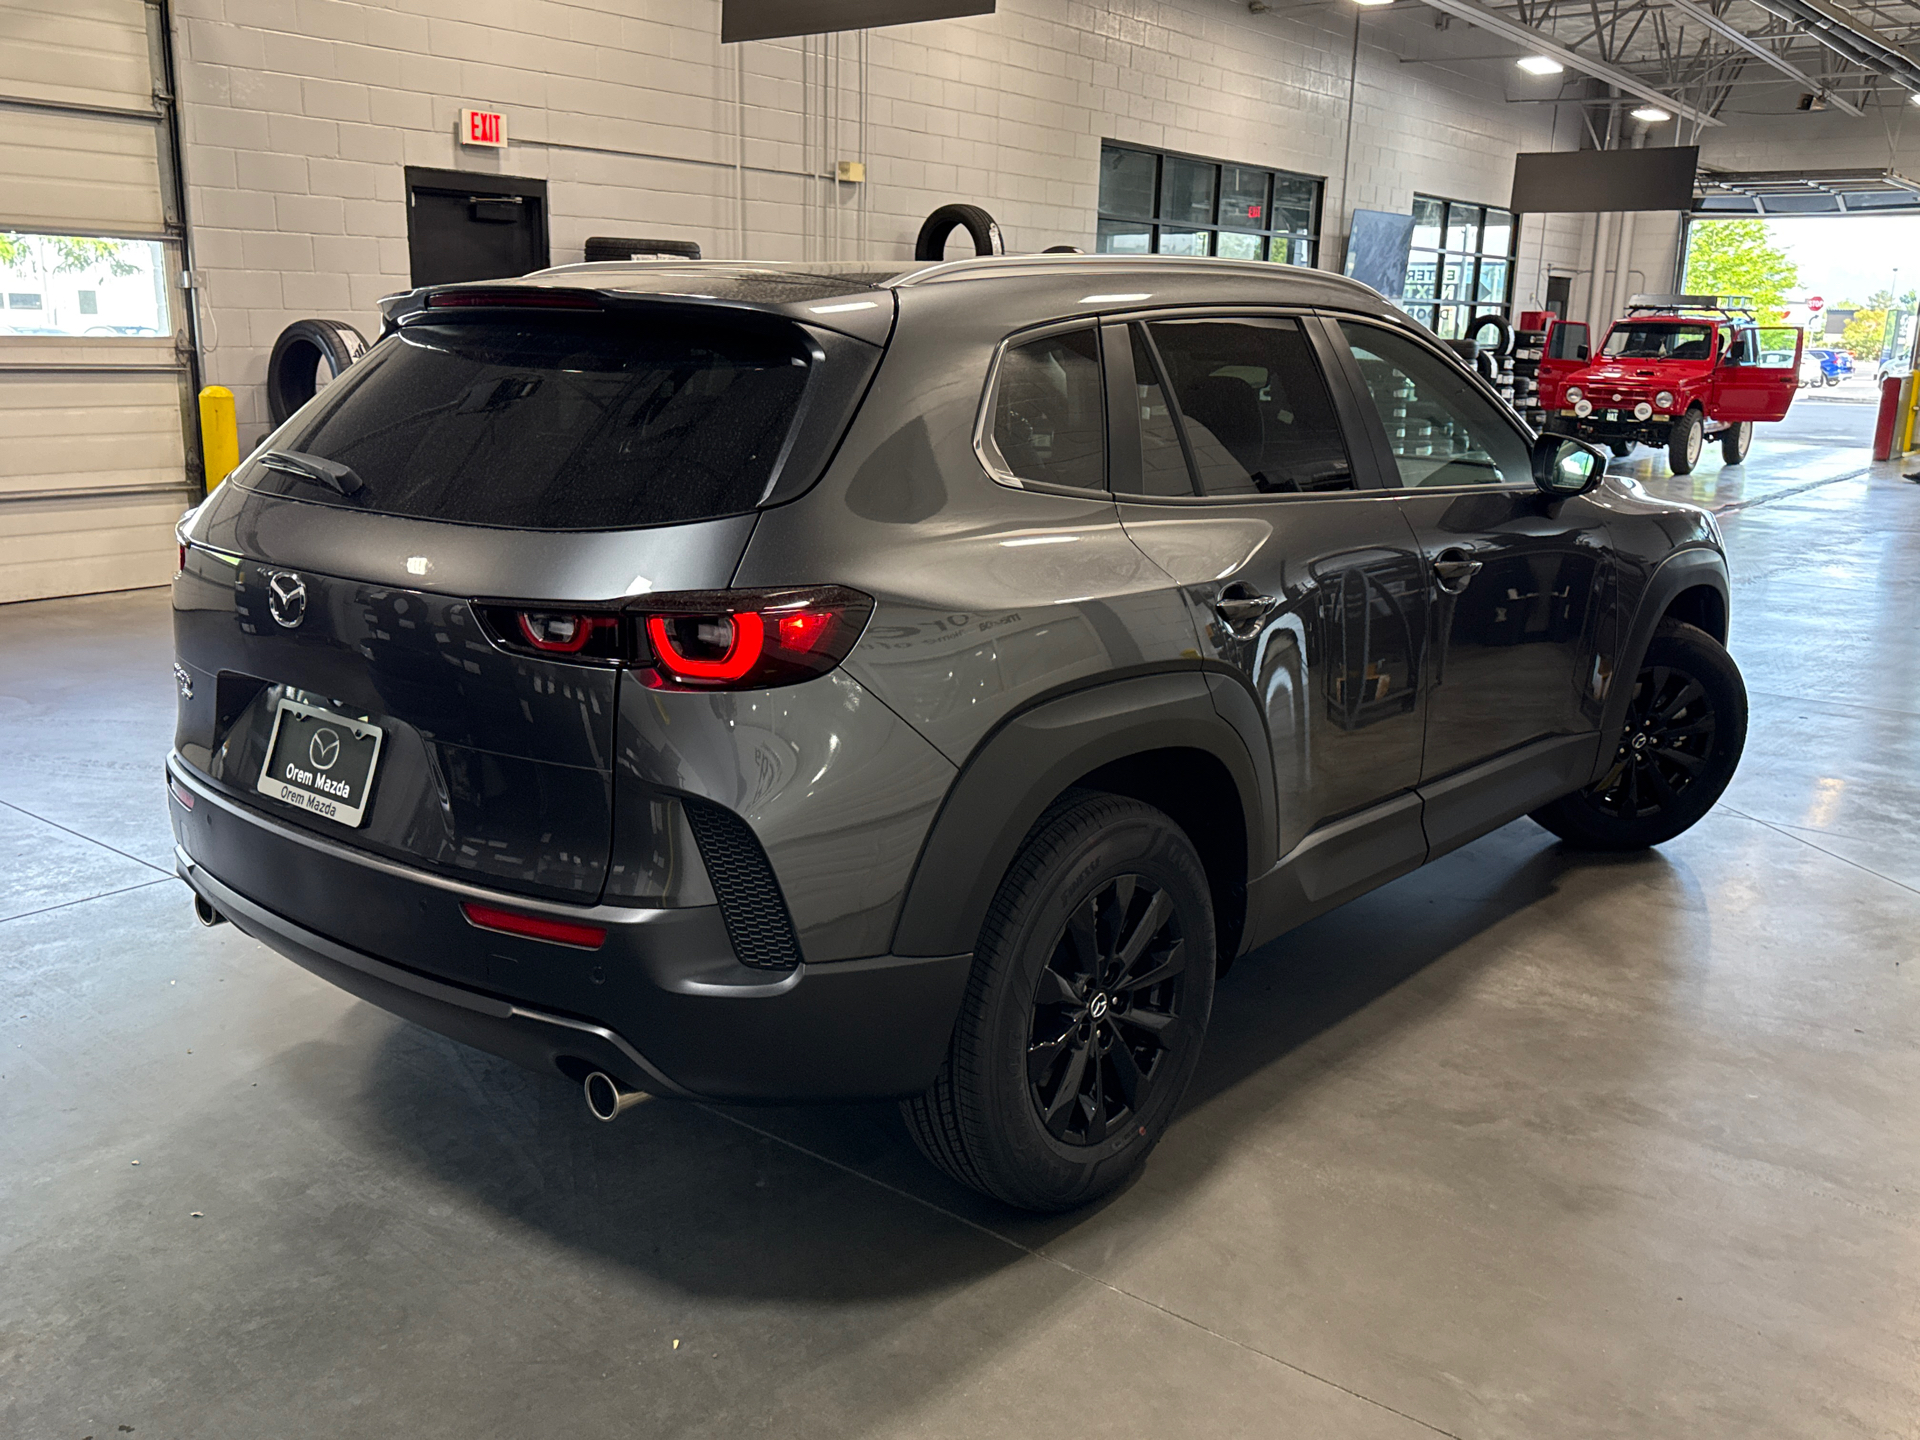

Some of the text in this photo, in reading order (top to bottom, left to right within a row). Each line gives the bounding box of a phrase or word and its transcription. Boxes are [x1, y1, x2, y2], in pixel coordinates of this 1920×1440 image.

[470, 111, 501, 143] EXIT
[1807, 299, 1824, 309] STOP
[286, 763, 350, 799] Orem Mazda
[281, 785, 337, 817] Orem Mazda
